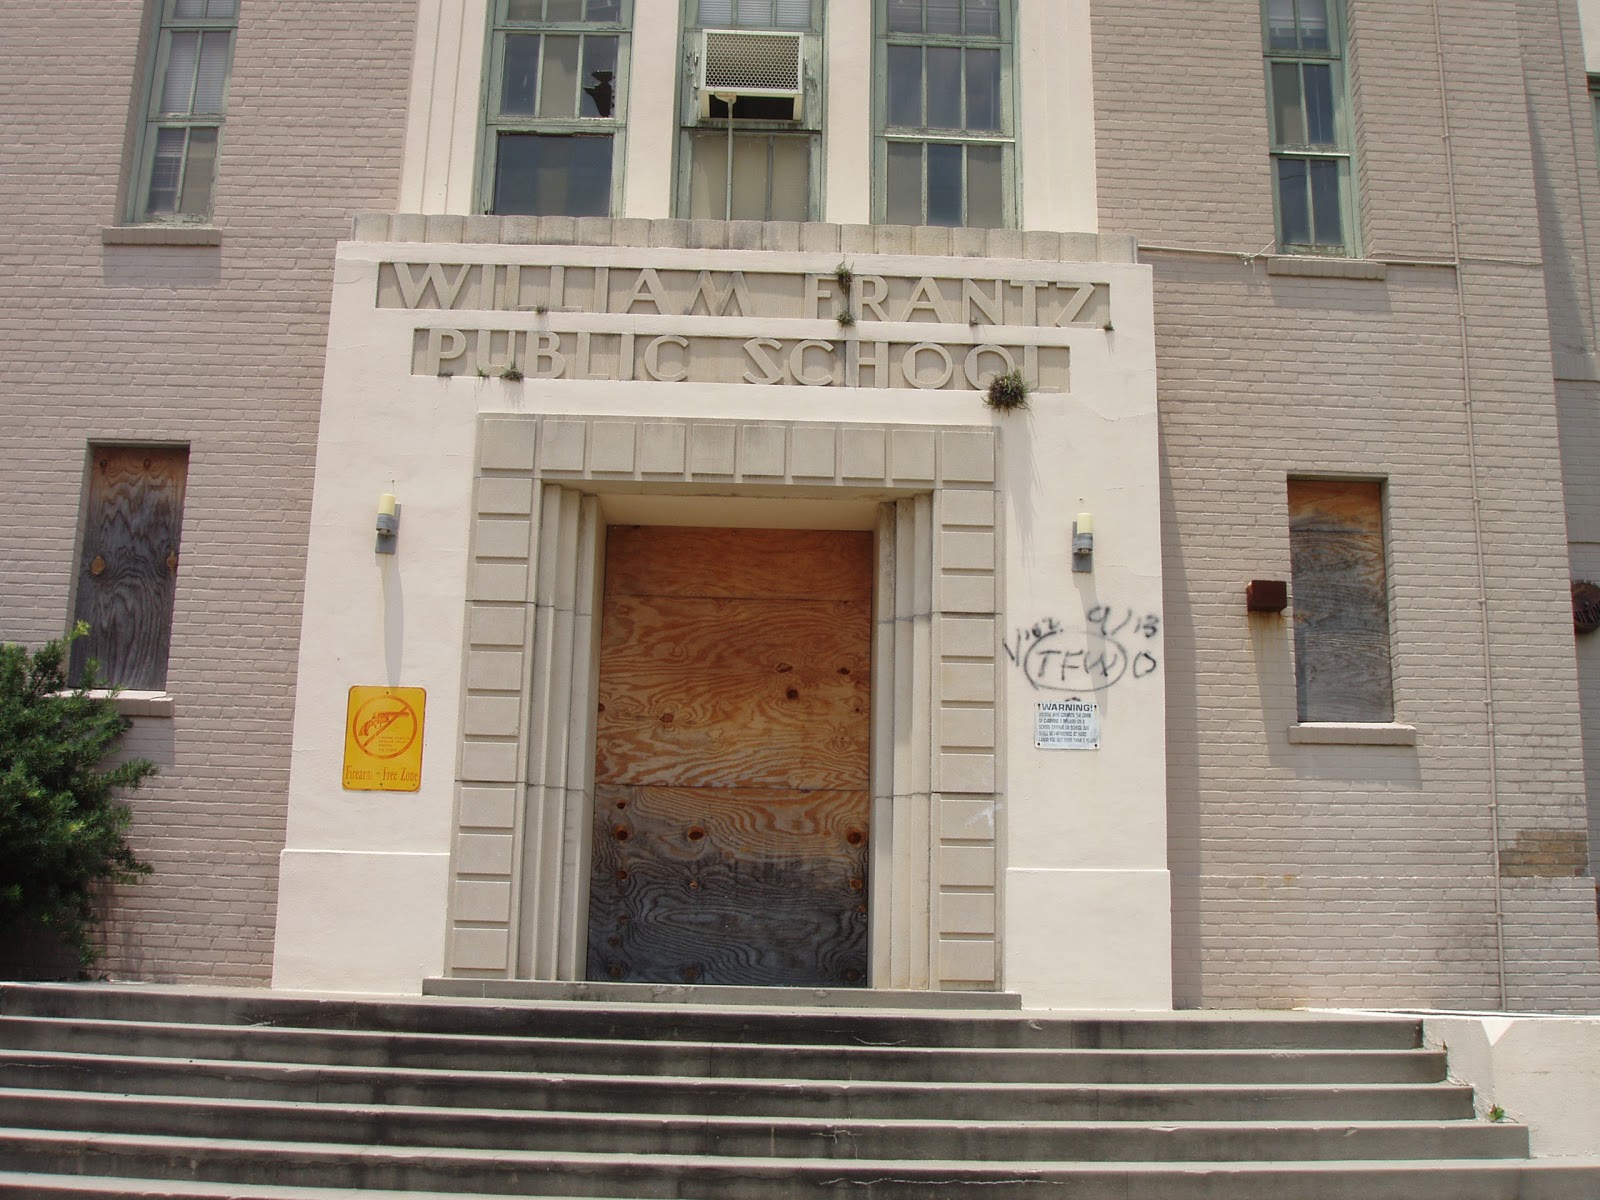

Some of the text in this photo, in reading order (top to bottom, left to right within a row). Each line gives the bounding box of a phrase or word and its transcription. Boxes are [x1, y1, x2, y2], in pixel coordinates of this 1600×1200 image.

[393, 262, 1096, 327] WILLIAM FRANTZ
[425, 328, 1059, 391] PUBLIC SCHOOL
[1041, 703, 1093, 712] WARNING!
[382, 766, 398, 781] Free
[400, 767, 419, 782] Zone
